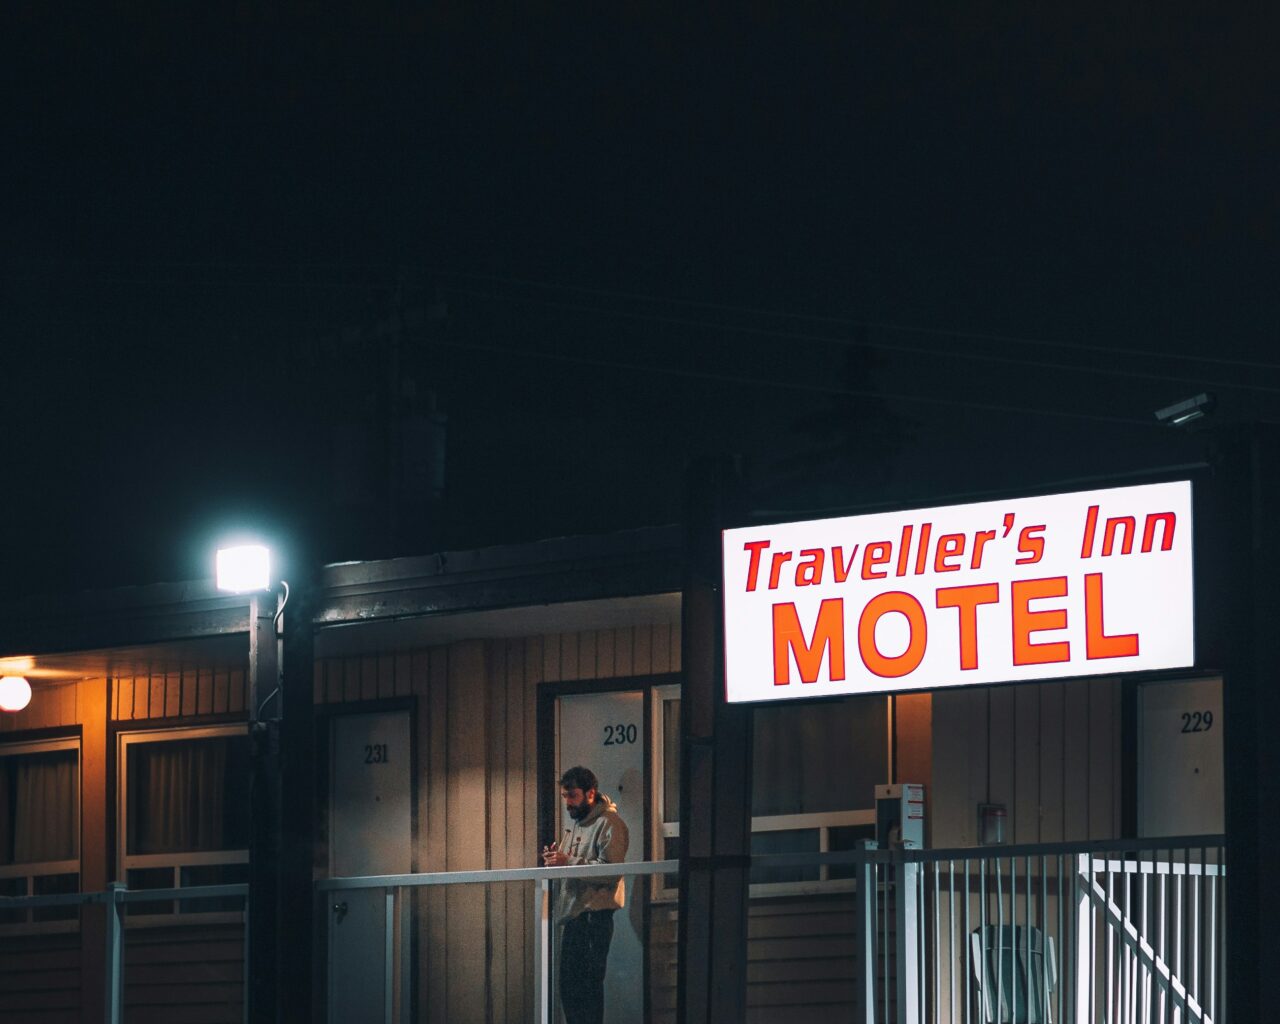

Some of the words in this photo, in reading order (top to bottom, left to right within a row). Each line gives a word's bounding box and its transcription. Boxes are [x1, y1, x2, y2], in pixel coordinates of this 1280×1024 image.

[743, 512, 1047, 593] Traveller's
[1081, 505, 1177, 559] Inn
[772, 572, 1140, 687] MOTEL
[1181, 710, 1213, 733] 229
[603, 723, 637, 746] 230
[364, 743, 388, 765] 231
